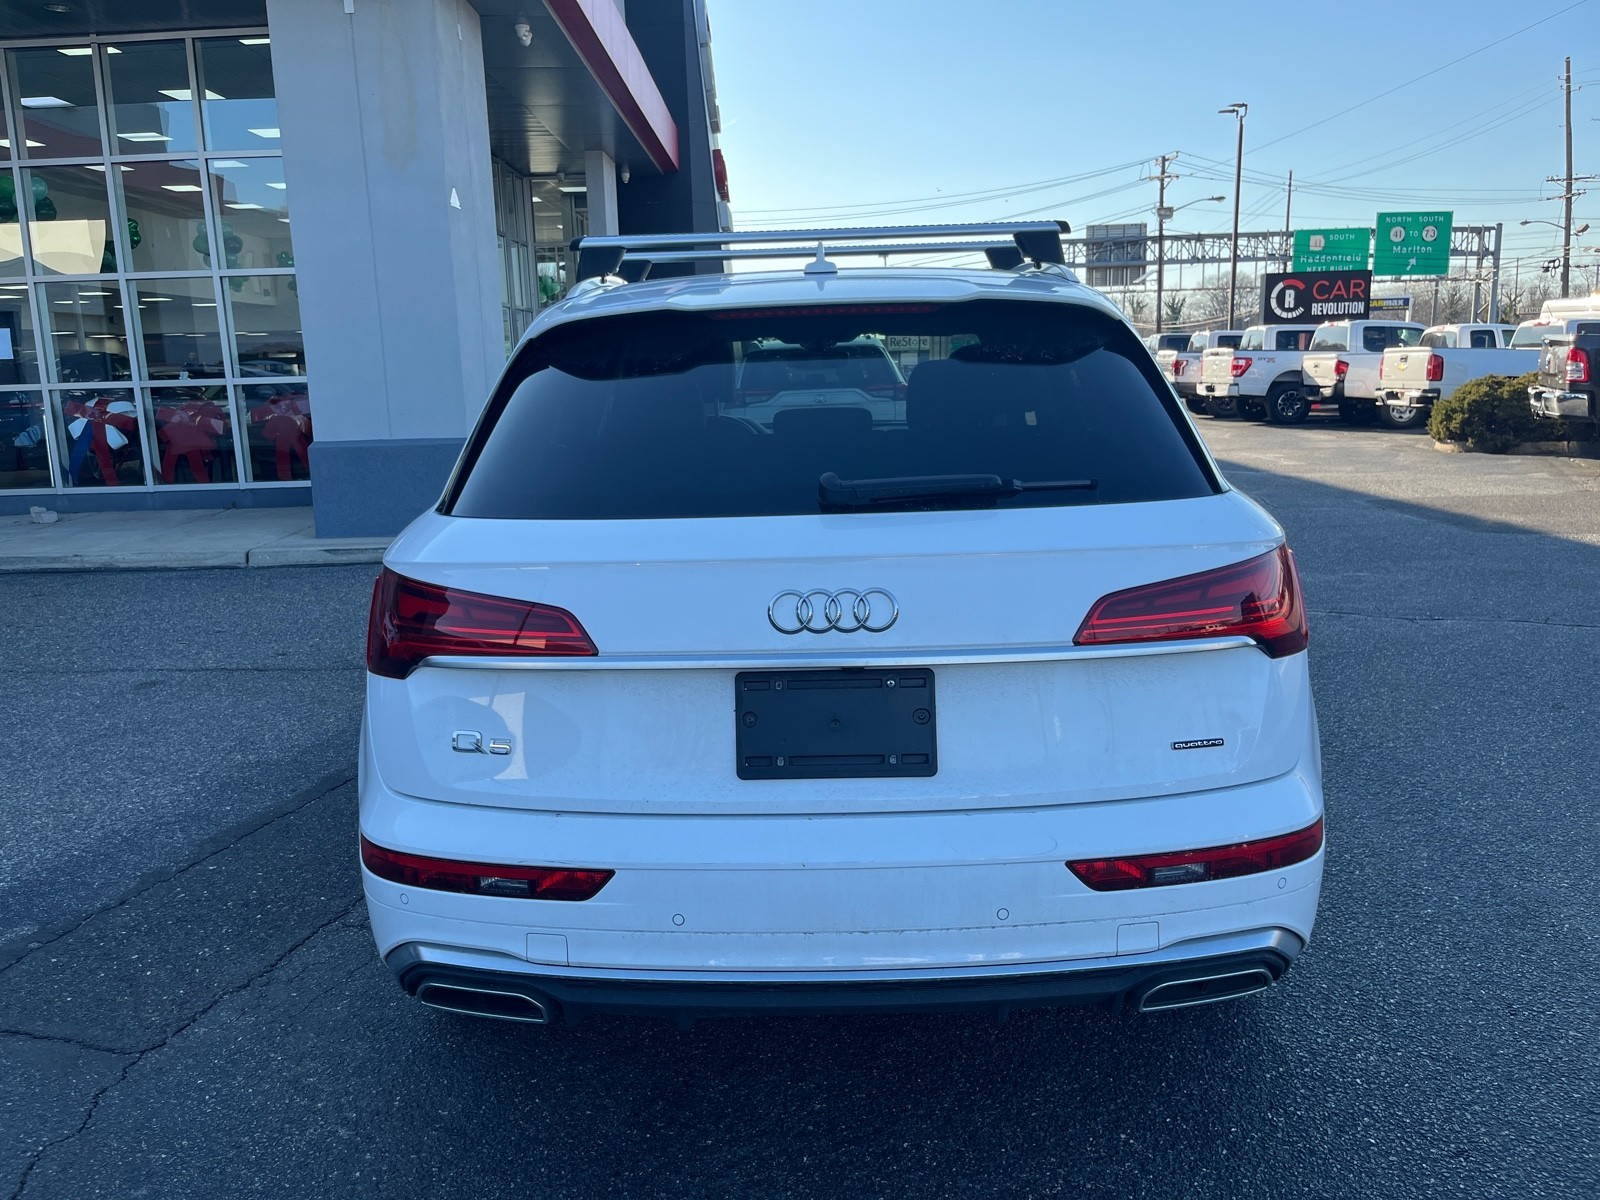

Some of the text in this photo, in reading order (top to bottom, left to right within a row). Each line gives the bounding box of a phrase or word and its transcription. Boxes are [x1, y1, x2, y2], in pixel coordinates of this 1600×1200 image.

[1329, 233, 1355, 241] SOUTH
[1392, 230, 1402, 239] 41
[1424, 229, 1436, 238] 73
[1392, 245, 1433, 254] Marlton
[1329, 264, 1353, 272] RIGHT
[1312, 279, 1366, 300] CAR
[1370, 298, 1404, 307] ARmax
[1311, 301, 1365, 316] REVOLUTION
[452, 730, 512, 755] Q5
[1174, 739, 1223, 749] quattro
